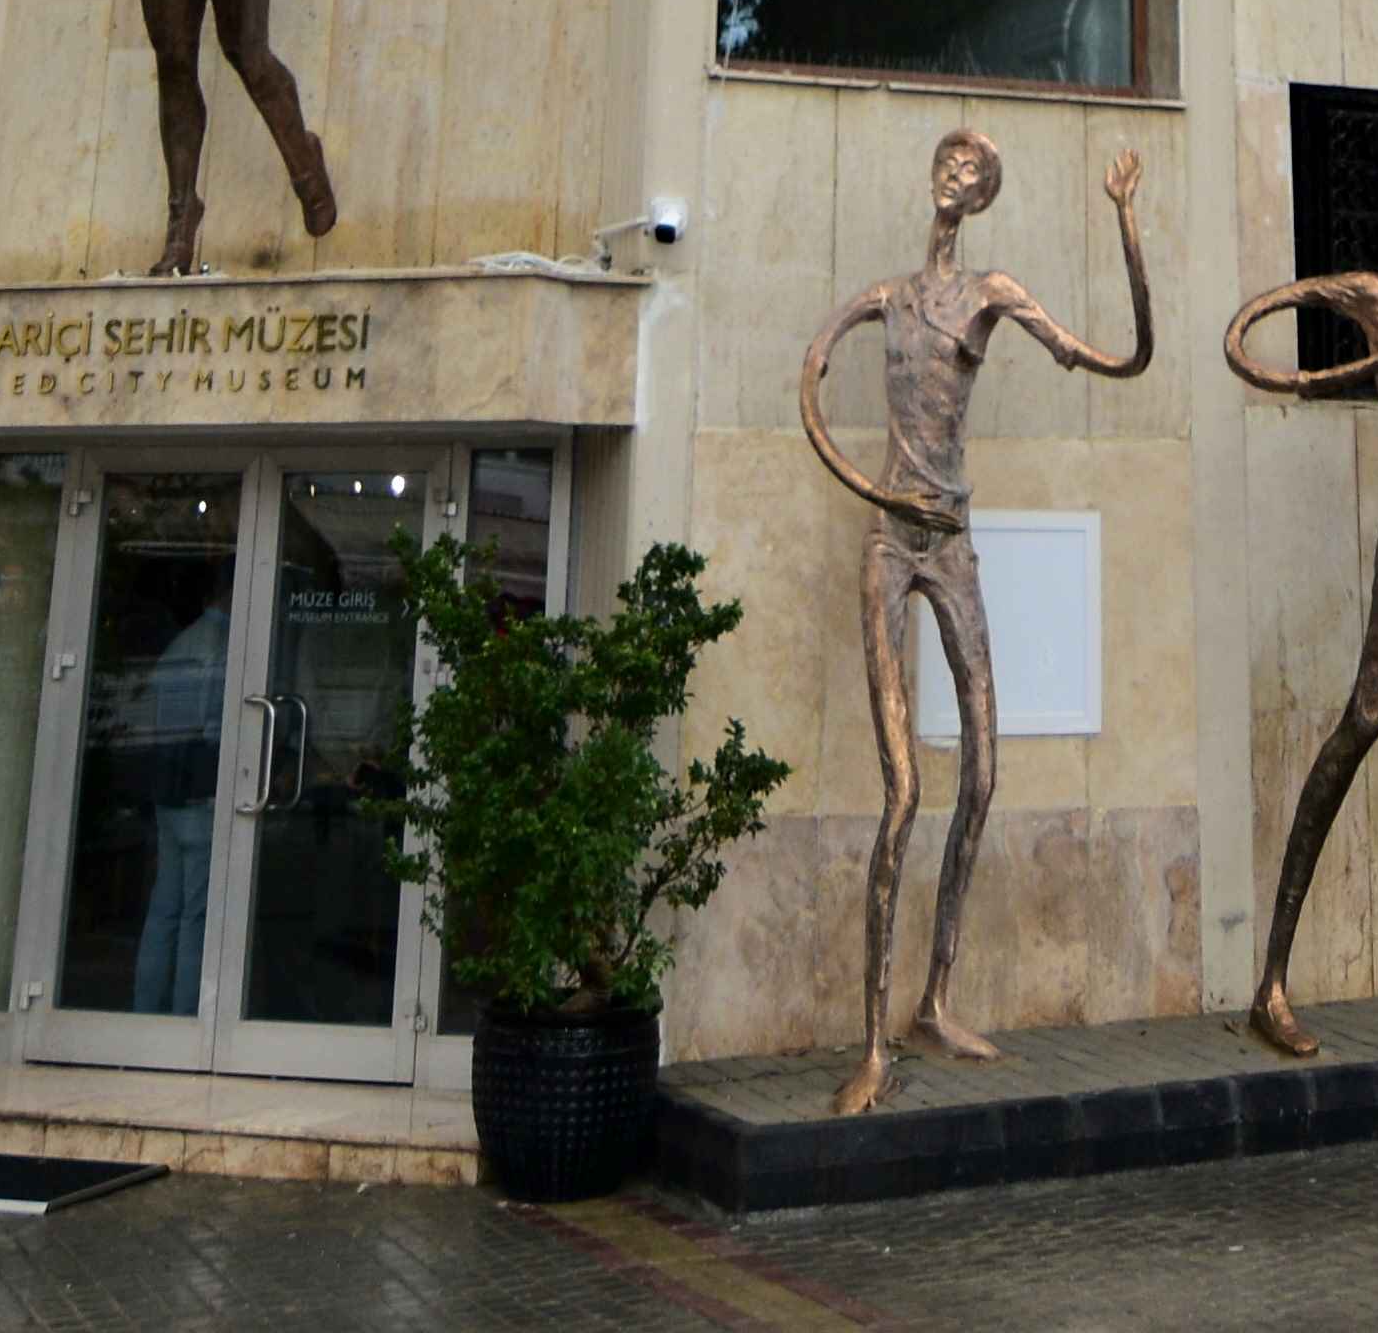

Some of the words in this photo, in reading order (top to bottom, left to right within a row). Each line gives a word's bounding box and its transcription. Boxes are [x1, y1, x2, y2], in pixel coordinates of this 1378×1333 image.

[103, 308, 212, 360] ŞEHİR
[222, 304, 370, 355] MÜZESİ
[76, 370, 174, 395] CITY
[194, 367, 367, 393] MUSEUM
[290, 589, 334, 607] MÜZE
[339, 588, 376, 611] GİRİŞ
